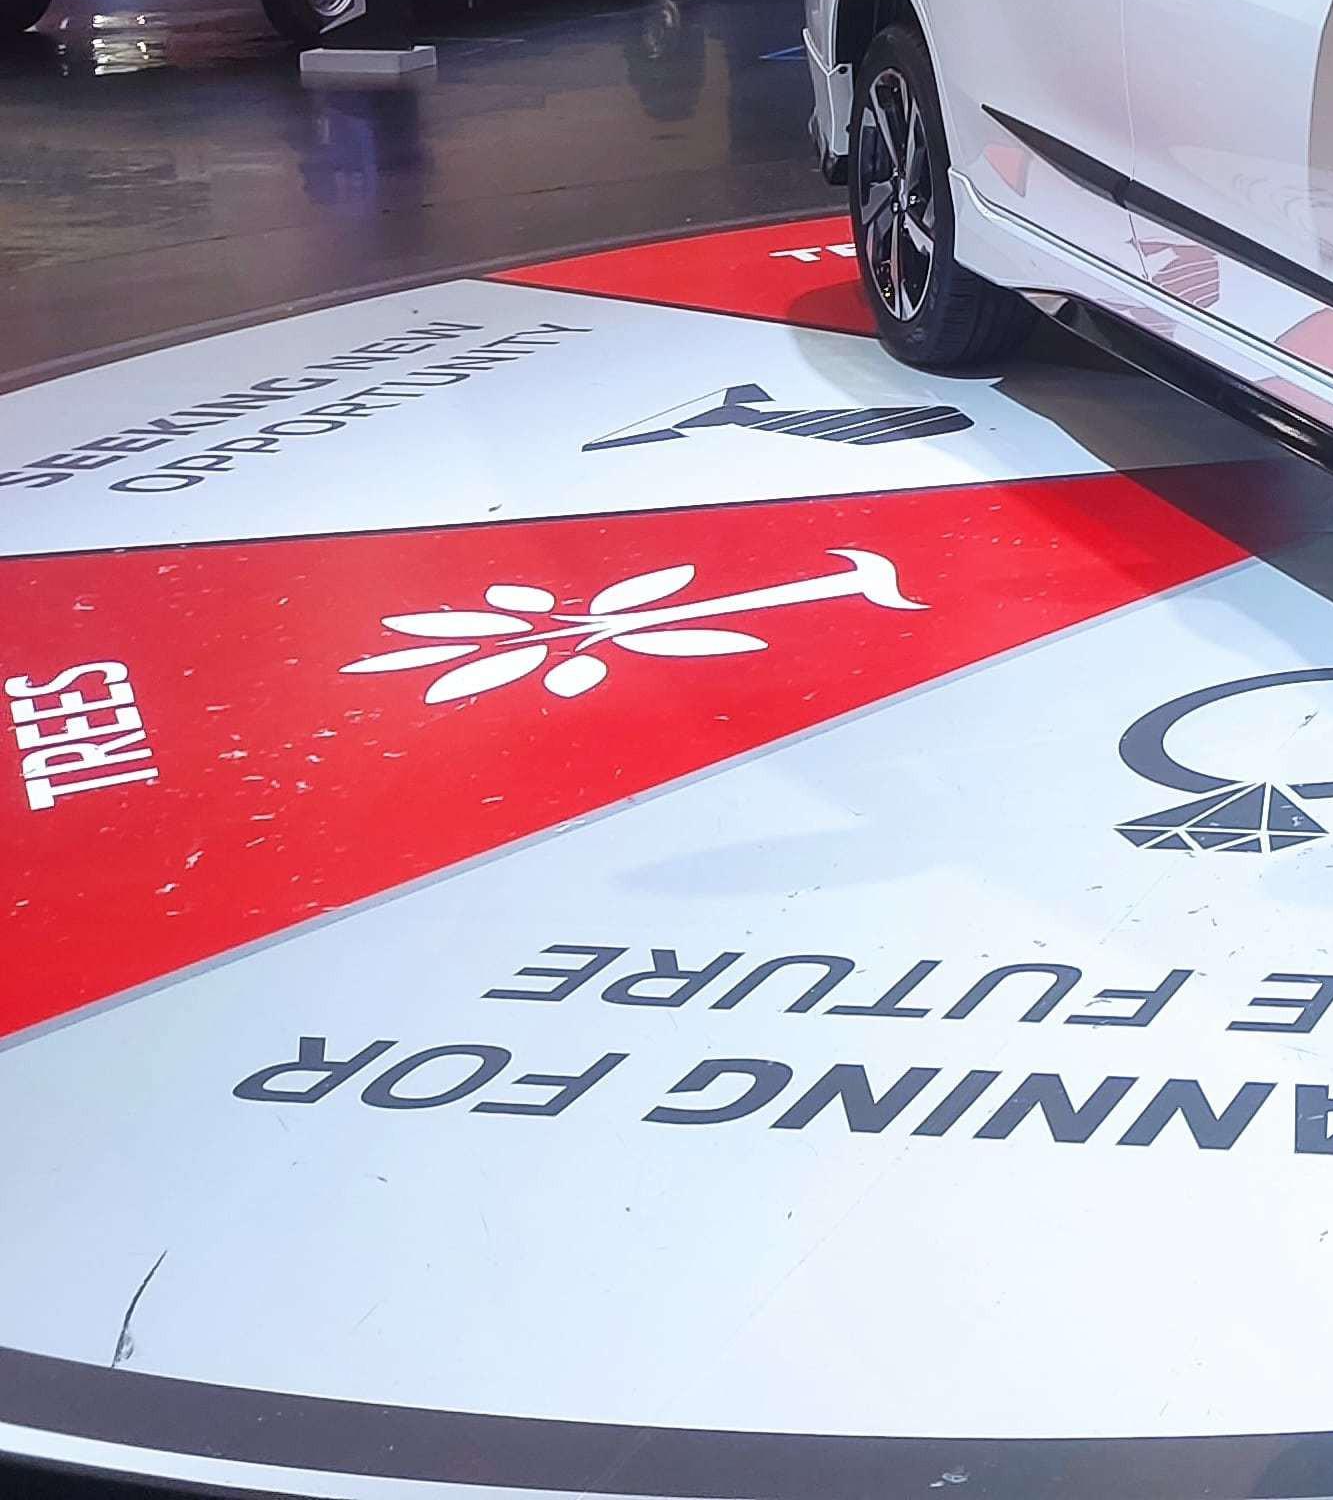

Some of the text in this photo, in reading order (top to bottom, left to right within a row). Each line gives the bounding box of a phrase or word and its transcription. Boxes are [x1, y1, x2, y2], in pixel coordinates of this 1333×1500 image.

[0, 320, 485, 489] SEEKING NEW
[108, 322, 594, 494] OPPORTUNITY
[4, 659, 160, 812] TREES
[480, 943, 1197, 1028] FUTURE
[232, 1036, 631, 1118] FOR
